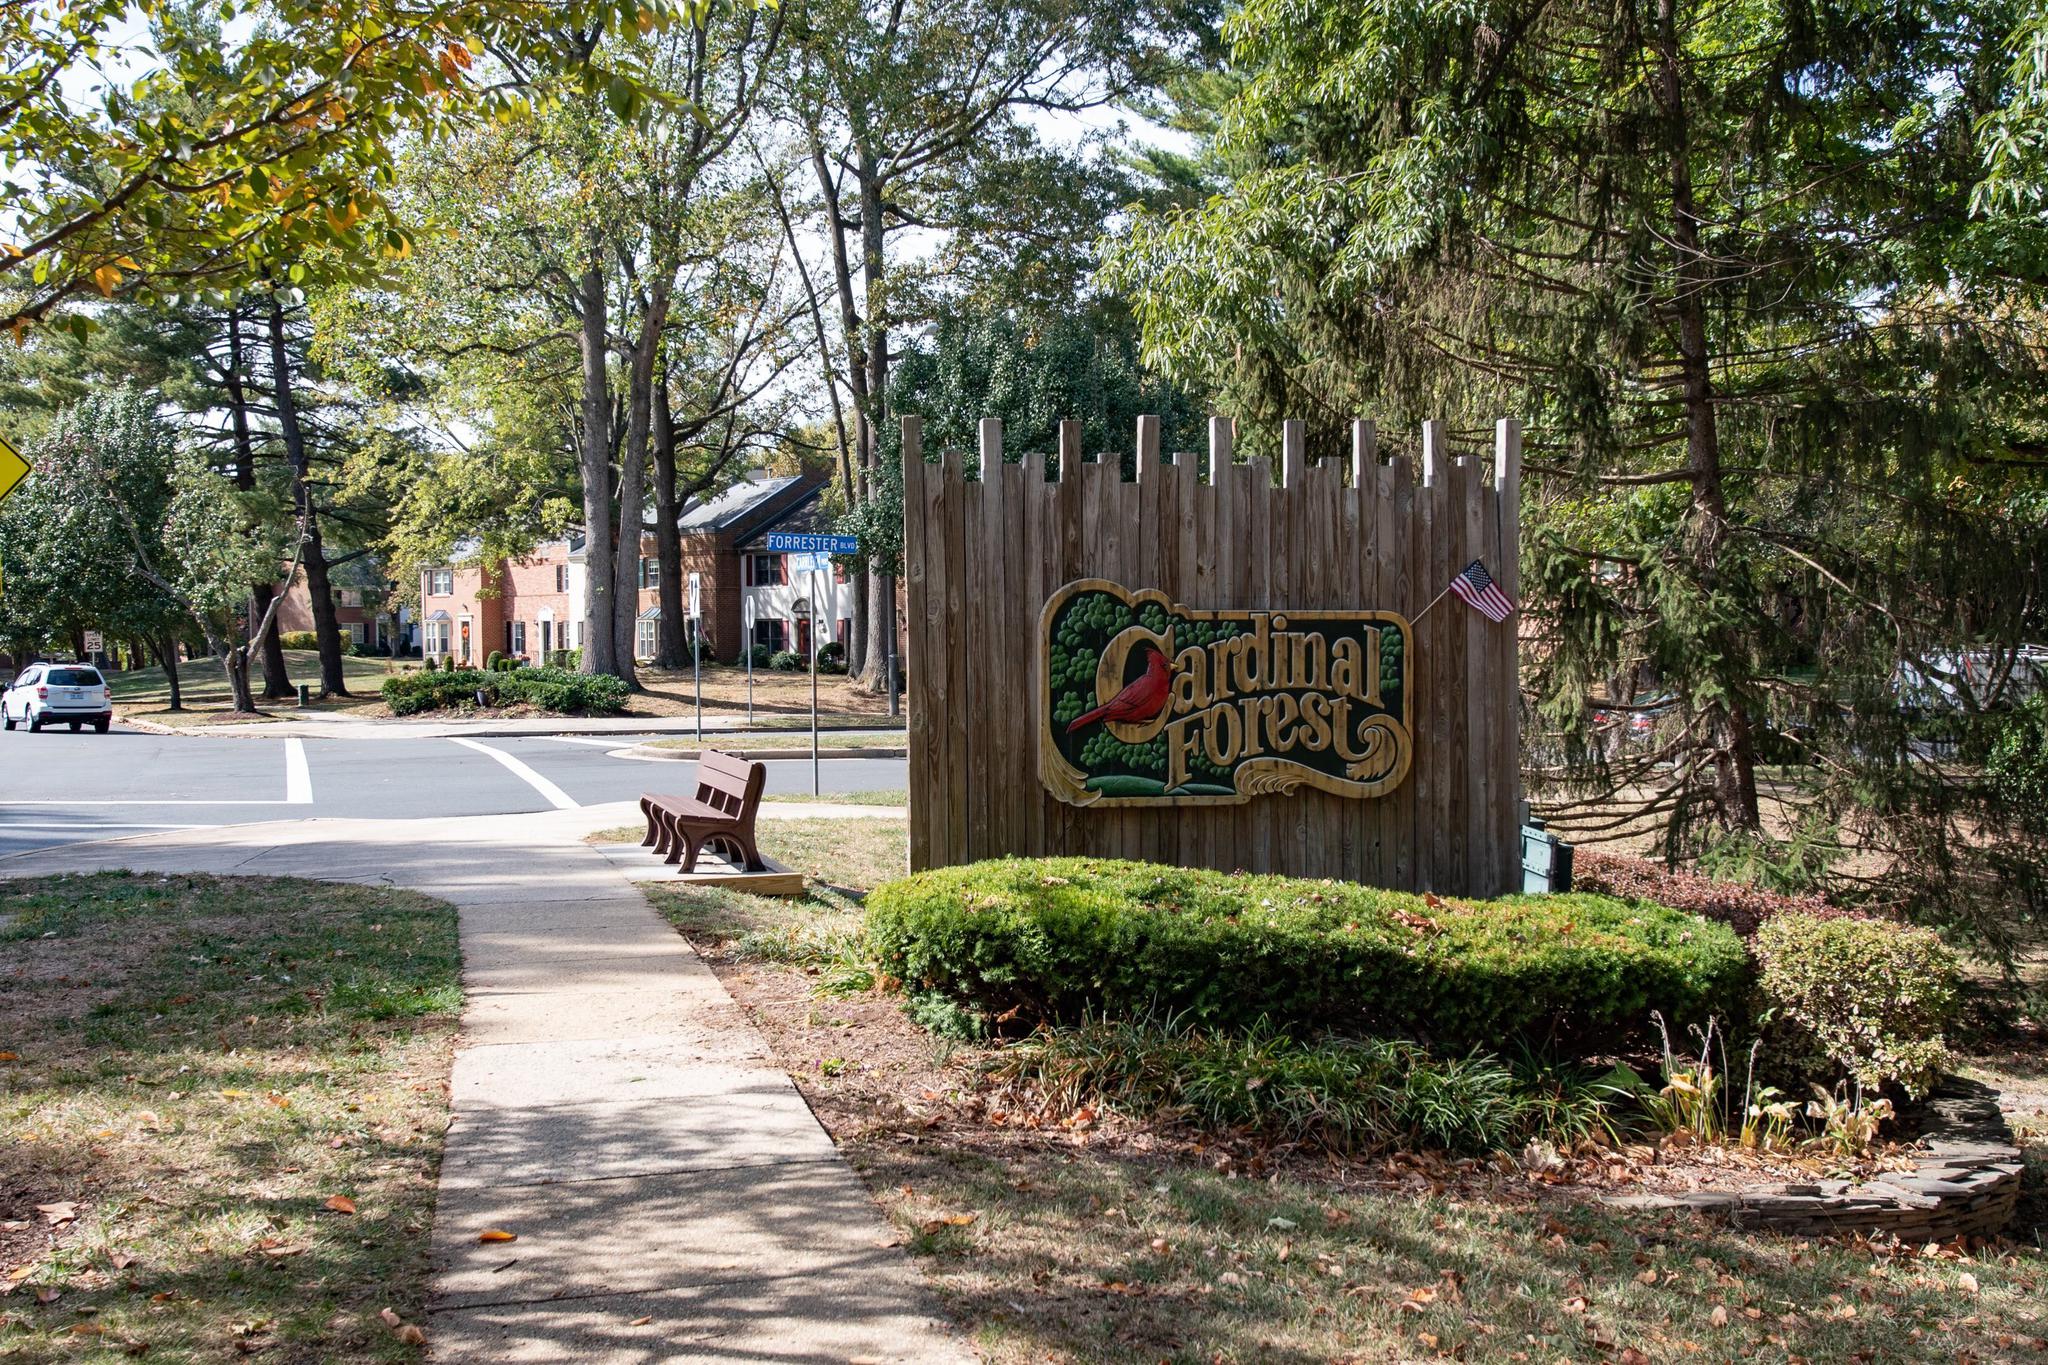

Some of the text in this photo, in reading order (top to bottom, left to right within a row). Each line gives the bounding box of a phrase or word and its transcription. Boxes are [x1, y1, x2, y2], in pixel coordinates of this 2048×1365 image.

[768, 534, 855, 551] FORRESTER BLVD
[87, 641, 101, 650] 25
[1096, 612, 1386, 744] Cardinal
[1163, 691, 1382, 793] Forest
